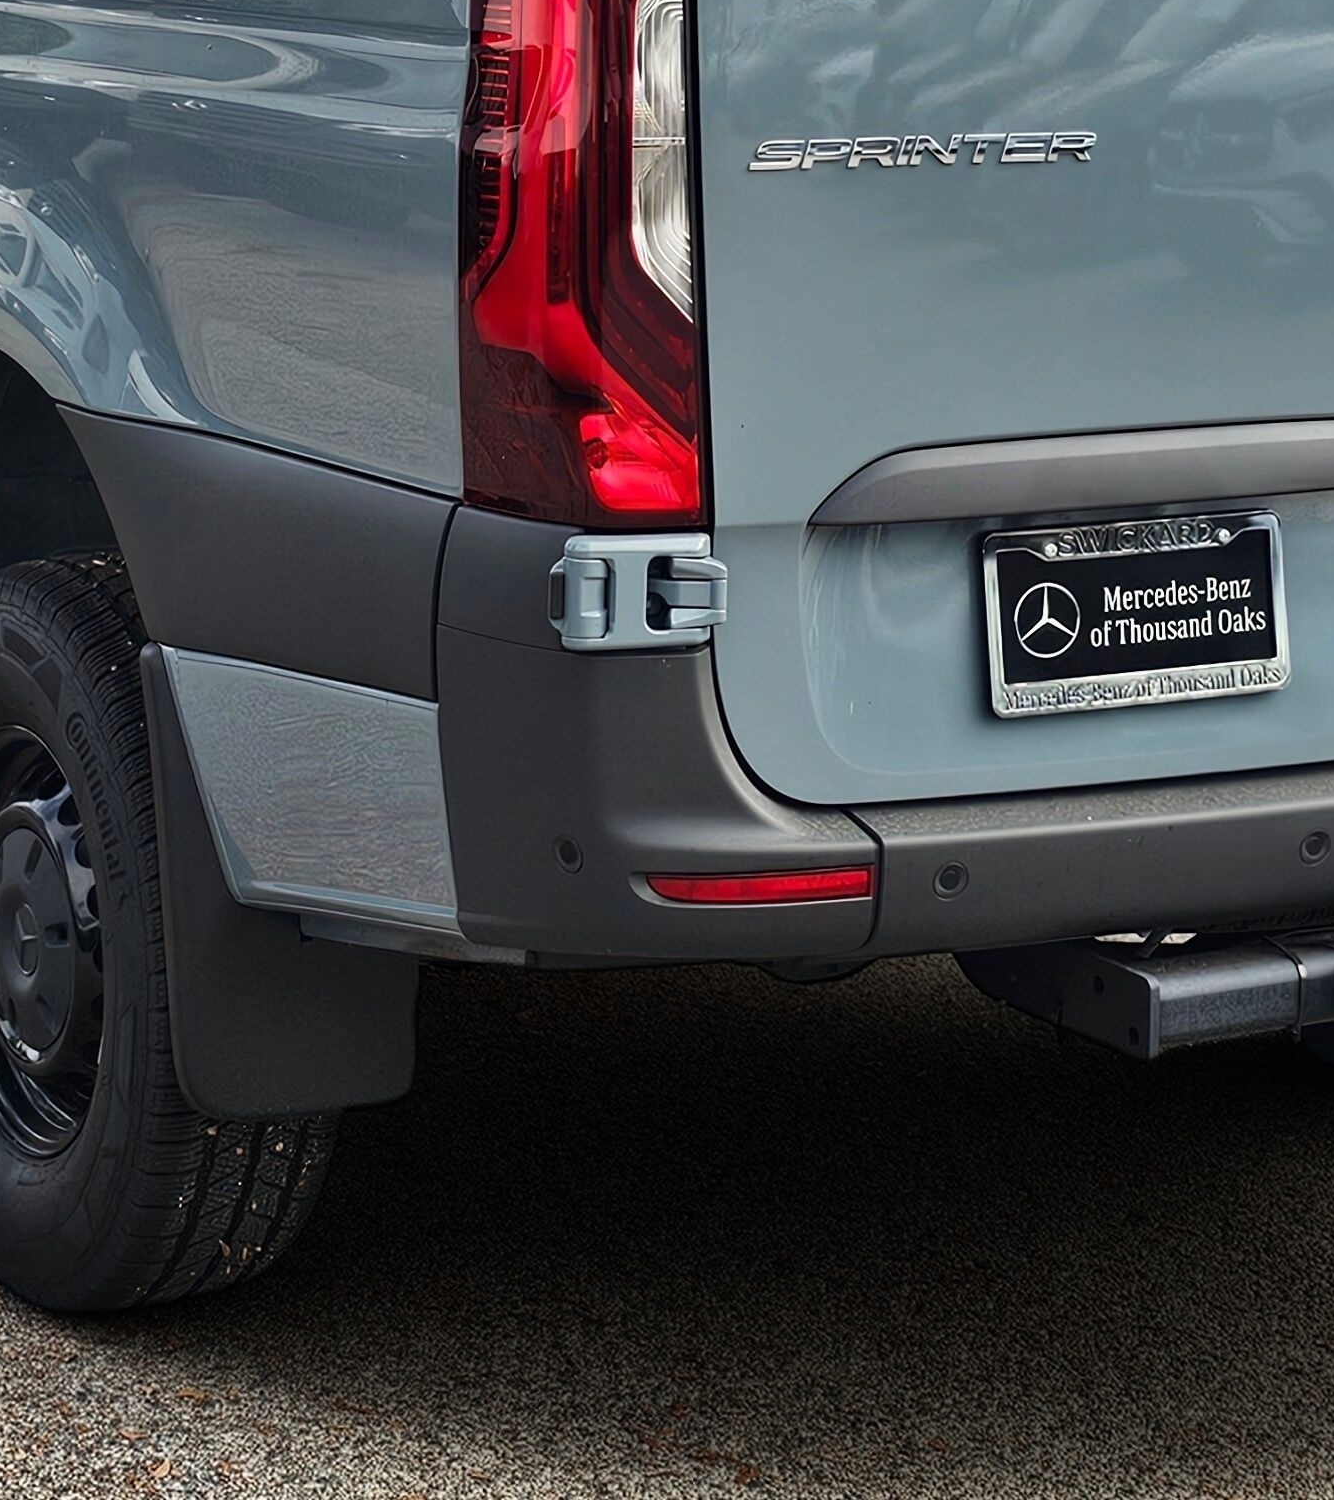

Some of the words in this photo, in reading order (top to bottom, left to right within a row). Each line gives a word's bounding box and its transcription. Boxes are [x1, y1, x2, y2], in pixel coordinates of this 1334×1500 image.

[748, 131, 1098, 171] SPRINTER
[1057, 519, 1215, 558] SWICKARD
[1103, 576, 1252, 613] Mercedes-Benz
[1089, 620, 1113, 648] of
[1115, 608, 1213, 646] Thousand
[1218, 606, 1267, 633] Oaks
[1157, 667, 1235, 695] Thousand
[1240, 663, 1282, 687] Oaks
